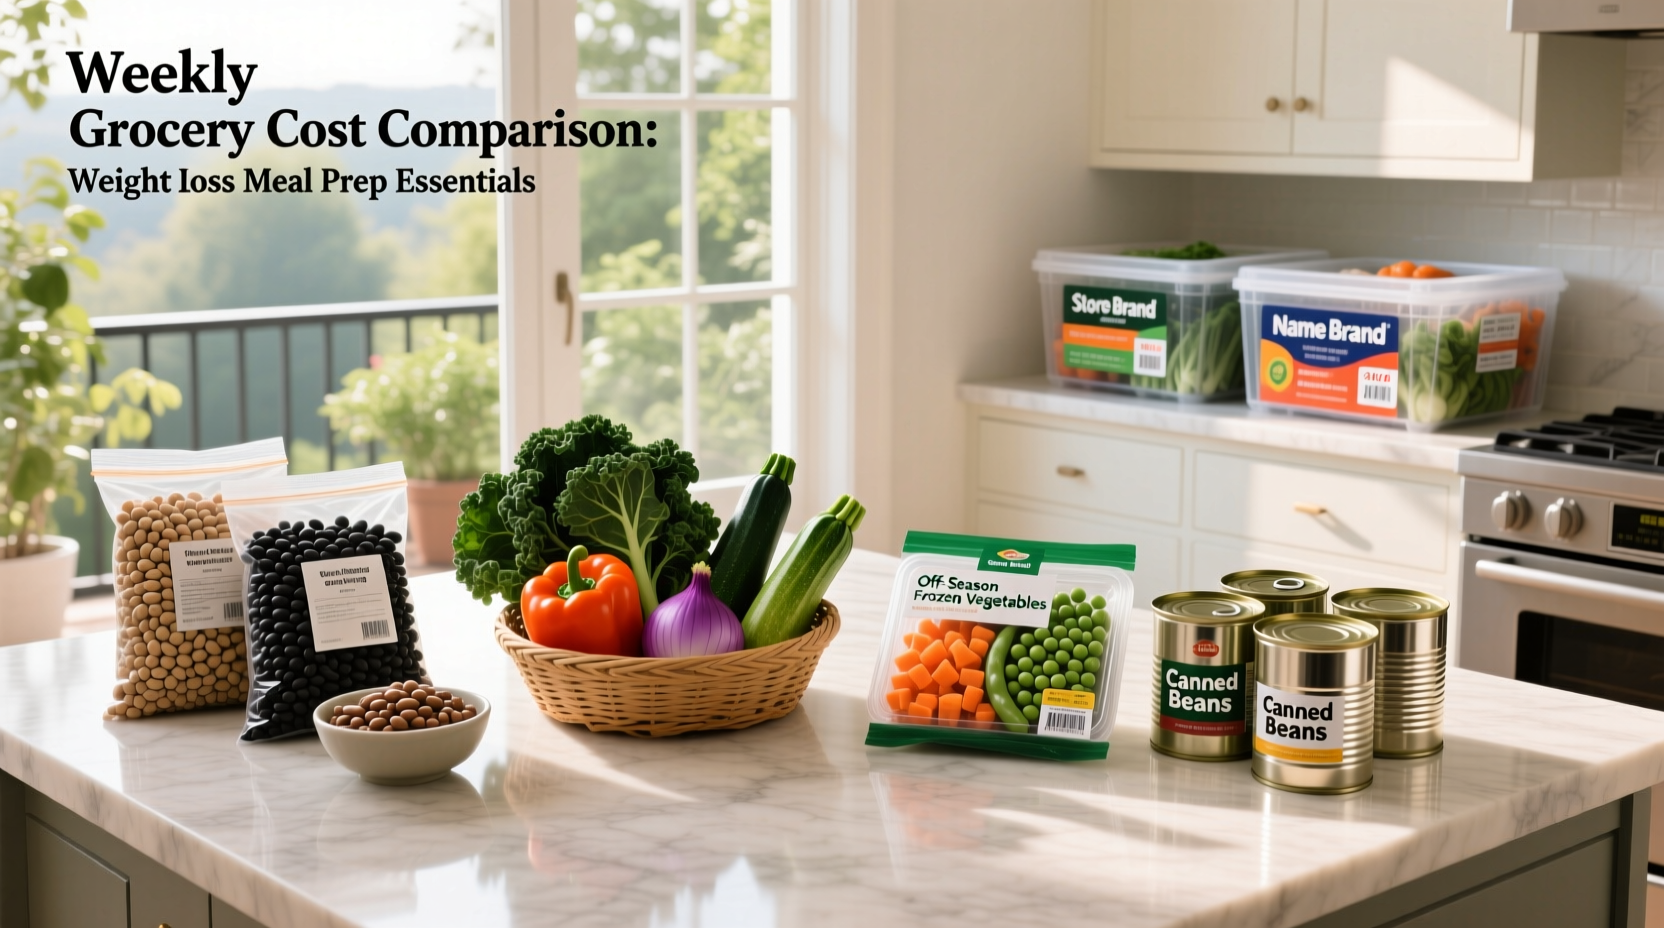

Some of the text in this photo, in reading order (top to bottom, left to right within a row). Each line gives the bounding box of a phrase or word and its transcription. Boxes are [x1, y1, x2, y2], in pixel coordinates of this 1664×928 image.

[1112, 296, 1157, 319] Brand
[1272, 314, 1387, 346] Name Brand
[913, 590, 962, 605] Frozen
[966, 592, 1047, 611] Vegetables
[1166, 668, 1238, 691] Canned
[1168, 689, 1232, 713] Beans
[1263, 696, 1334, 721] Canned
[1265, 716, 1328, 742] Beans
